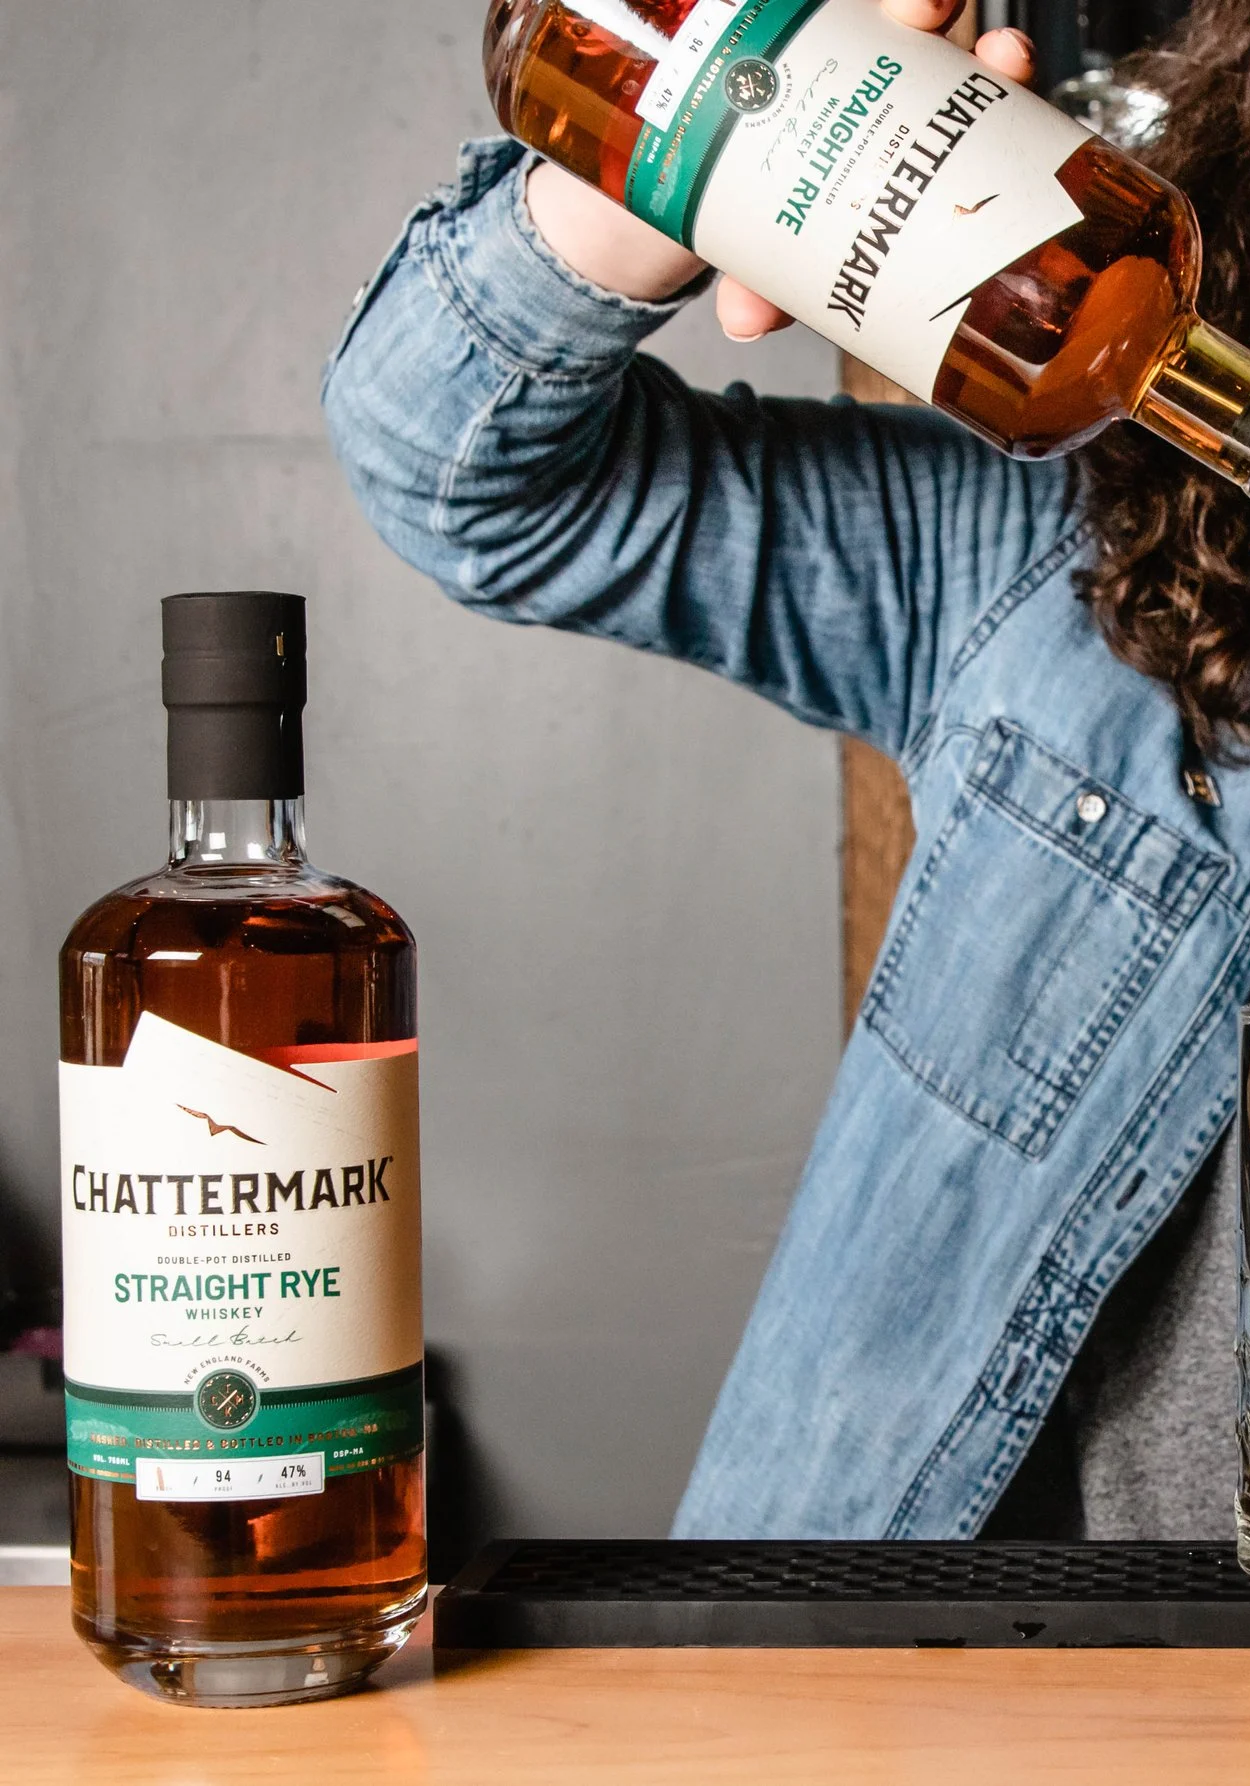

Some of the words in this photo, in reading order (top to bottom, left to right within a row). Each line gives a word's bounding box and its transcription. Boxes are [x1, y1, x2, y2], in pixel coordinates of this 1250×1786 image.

[689, 38, 703, 53] 94
[783, 63, 793, 80] NEW
[656, 88, 673, 111] 47%
[797, 97, 840, 158] WHISKEY
[808, 55, 903, 181] STRAIGHT
[855, 103, 894, 156] DOUBLE-POT
[825, 158, 856, 206] DISTILLED
[775, 177, 820, 236] RYE
[827, 72, 1010, 329] CHATTERMARK
[72, 1155, 391, 1216] CHATTERMARK
[168, 1223, 279, 1237] DISTILLERS
[157, 1256, 227, 1265] DOUBLE-POT
[232, 1252, 292, 1264] DISTILLED
[115, 1272, 272, 1303] STRAIGHT
[280, 1266, 341, 1299] RYE
[185, 1306, 263, 1320] WHISKEY
[184, 1367, 199, 1385] NEW
[200, 1355, 243, 1368] ENGLAND
[245, 1359, 270, 1383] FARMS
[135, 1437, 201, 1450] DISTILLED
[206, 1438, 215, 1450] &
[221, 1436, 284, 1450] BOTTLED
[289, 1434, 303, 1444] IN
[333, 1447, 364, 1459] DSP-MA
[215, 1470, 232, 1482] 94
[281, 1465, 306, 1479] 47%
